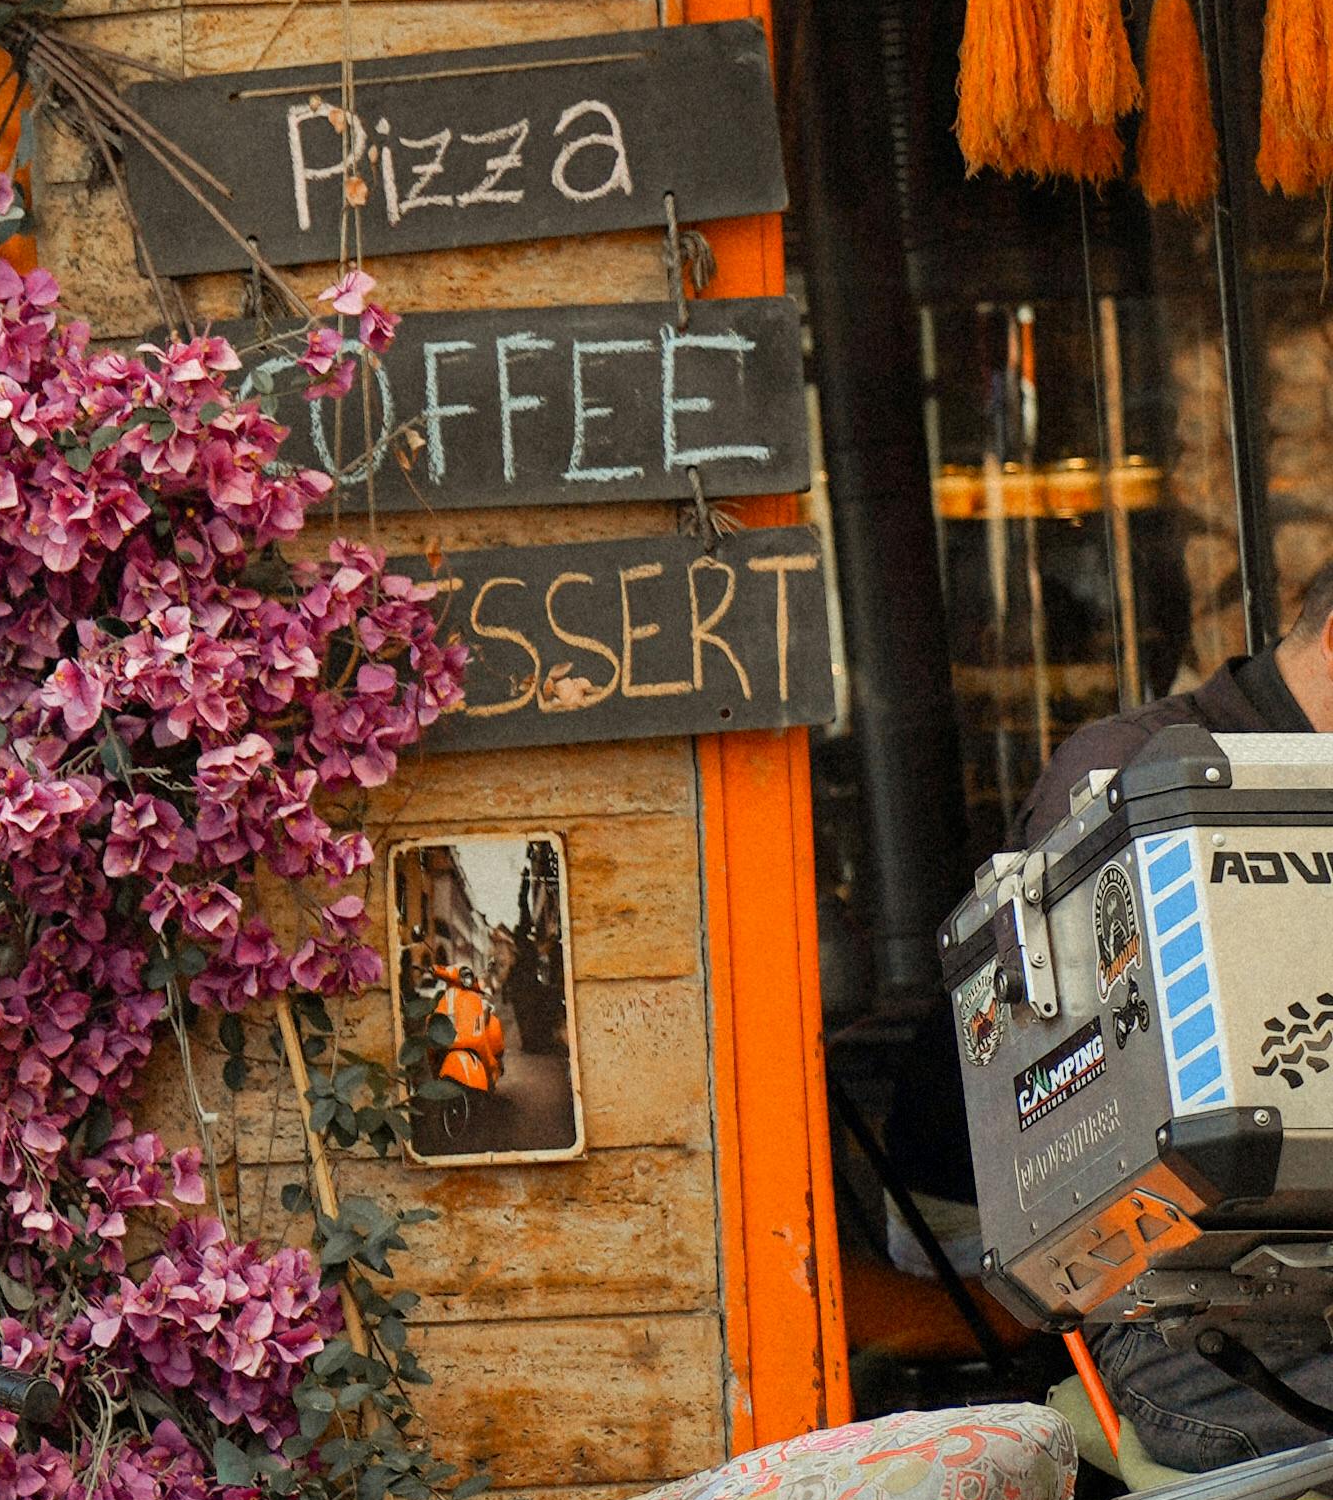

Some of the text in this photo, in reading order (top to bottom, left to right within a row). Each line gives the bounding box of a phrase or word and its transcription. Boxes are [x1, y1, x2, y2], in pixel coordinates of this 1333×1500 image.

[286, 99, 632, 230] Pizza
[1019, 1034, 1104, 1114] CAMPING
[1022, 1086, 1068, 1131] ADVENTURE
